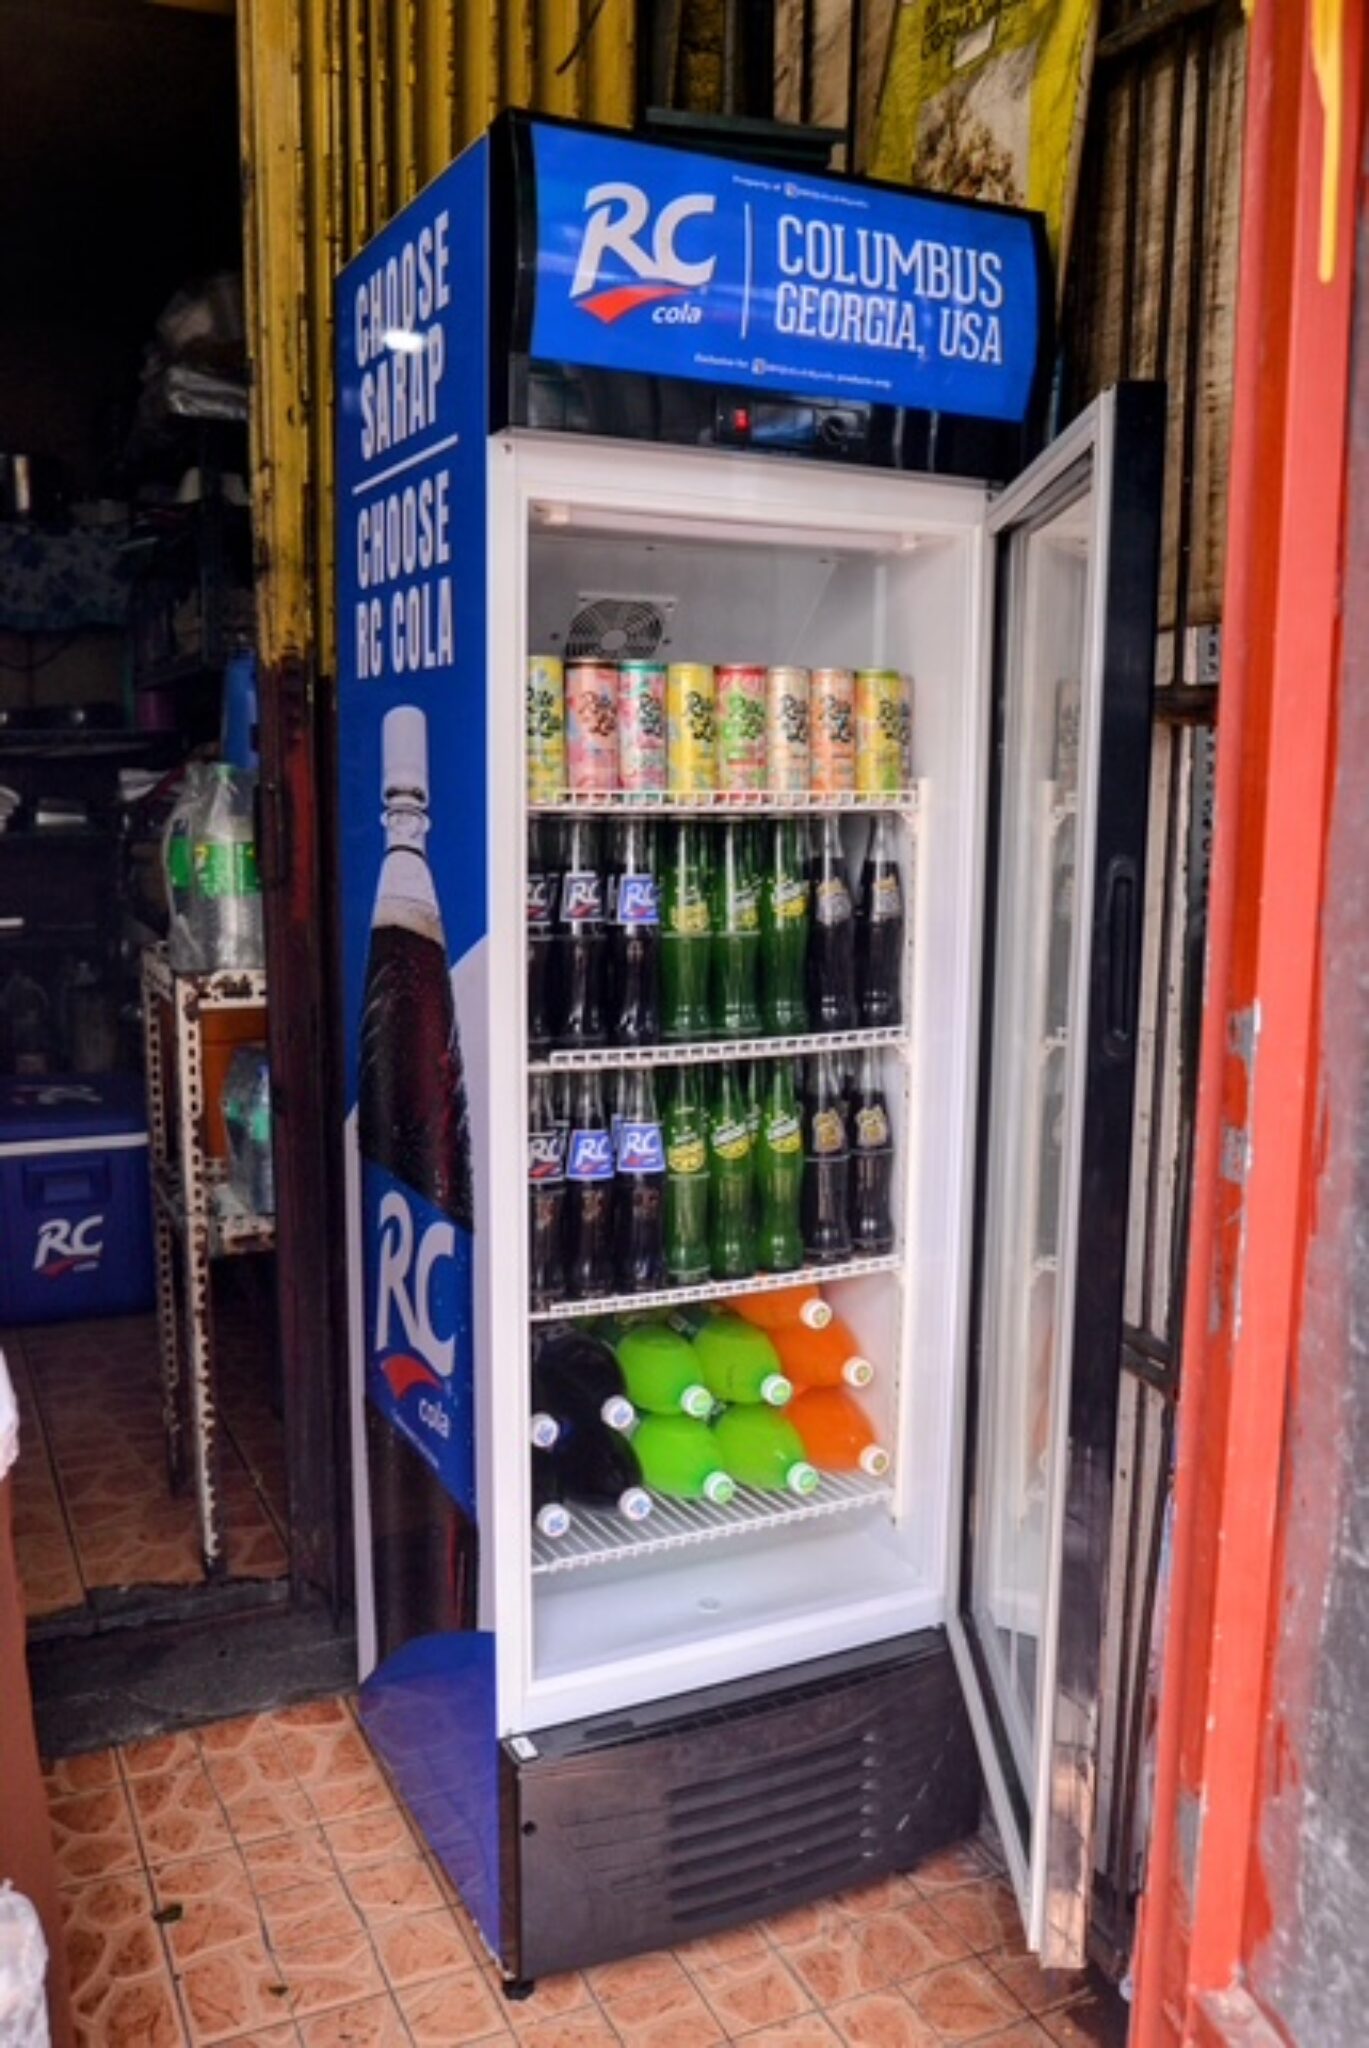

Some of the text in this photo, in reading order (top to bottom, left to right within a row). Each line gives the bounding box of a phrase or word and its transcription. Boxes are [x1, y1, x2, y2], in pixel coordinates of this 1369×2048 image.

[354, 209, 449, 368] CHOOSE
[569, 182, 716, 298] RC
[777, 215, 1002, 309] COLUMBUS
[652, 305, 701, 325] cola
[775, 281, 1002, 365] GEORGIA, USA
[361, 322, 443, 461] SARAP
[356, 469, 450, 590] CHOOSE
[355, 577, 455, 680] RC COLA
[575, 1135, 610, 1168] RC
[624, 1129, 659, 1160] RC
[33, 1214, 103, 1270] RC
[375, 1190, 455, 1377] RC
